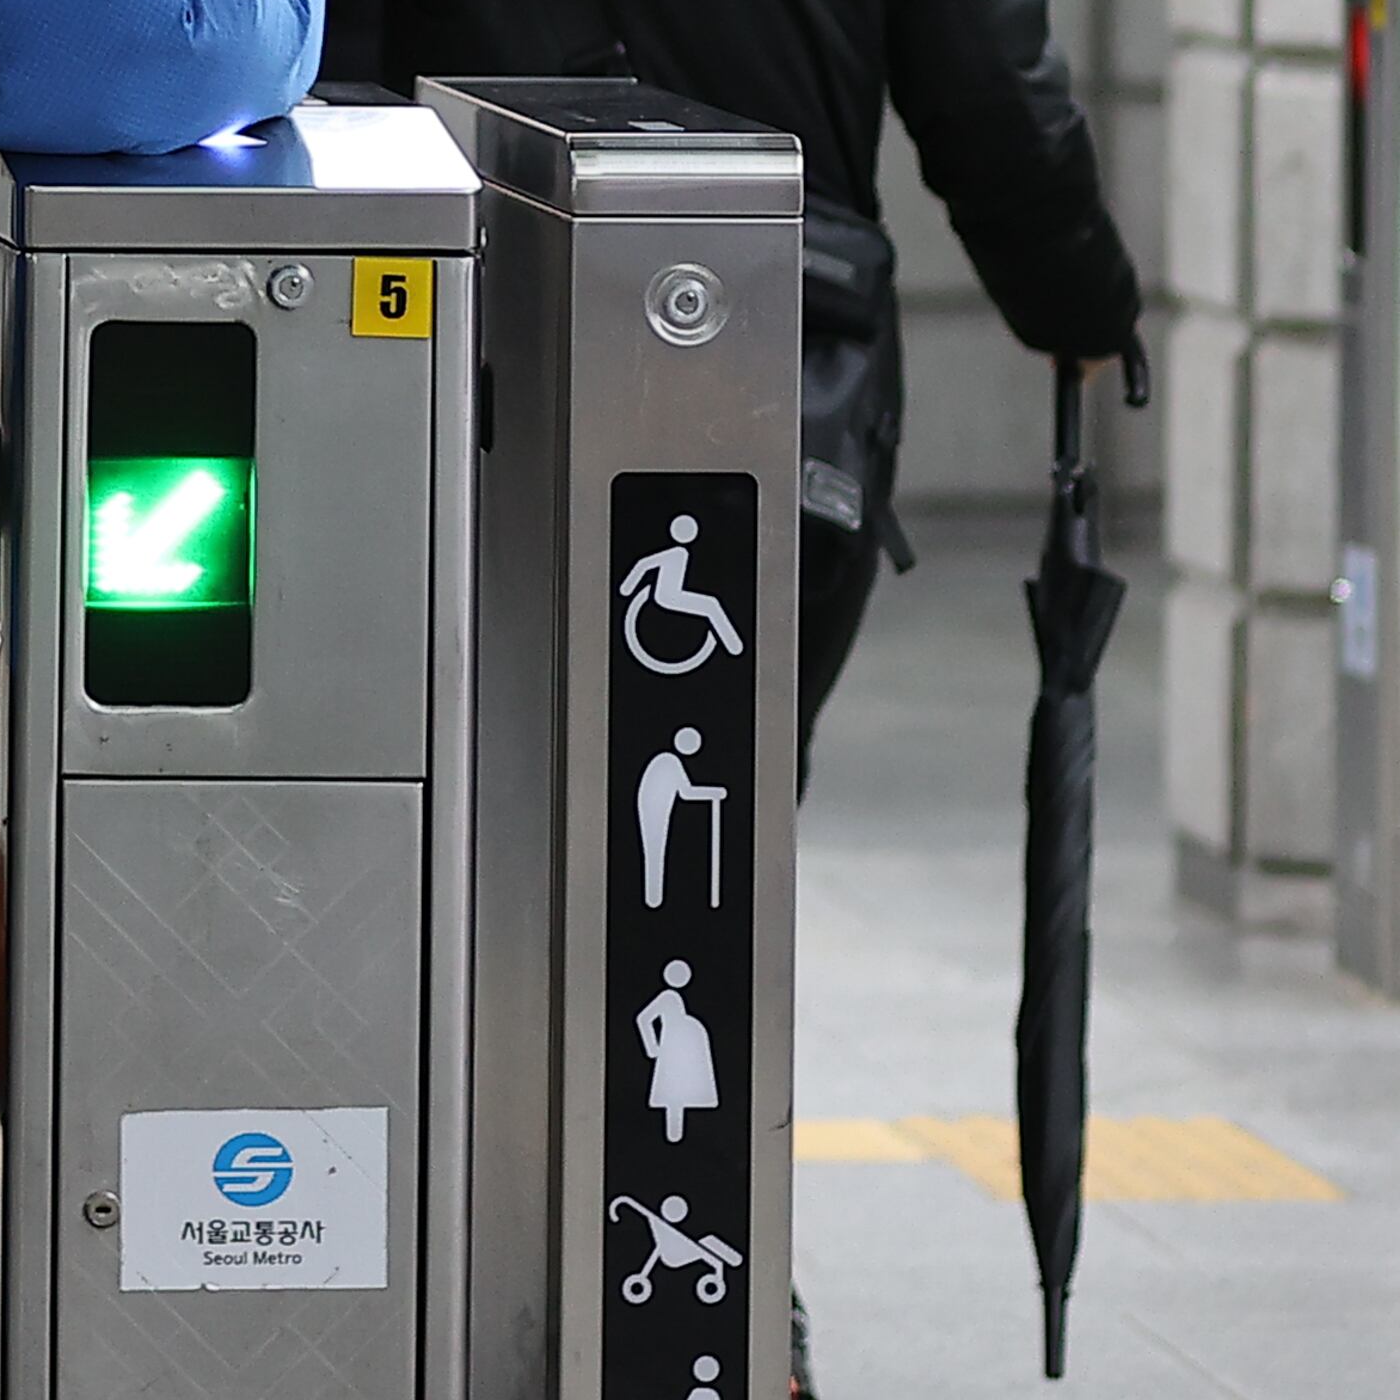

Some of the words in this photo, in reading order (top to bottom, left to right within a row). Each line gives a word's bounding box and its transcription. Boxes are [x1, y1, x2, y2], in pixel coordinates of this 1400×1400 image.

[379, 274, 407, 319] 5
[180, 1219, 326, 1246] 서울교통공사
[203, 1251, 248, 1266] Seoul
[253, 1251, 303, 1266] Metro
